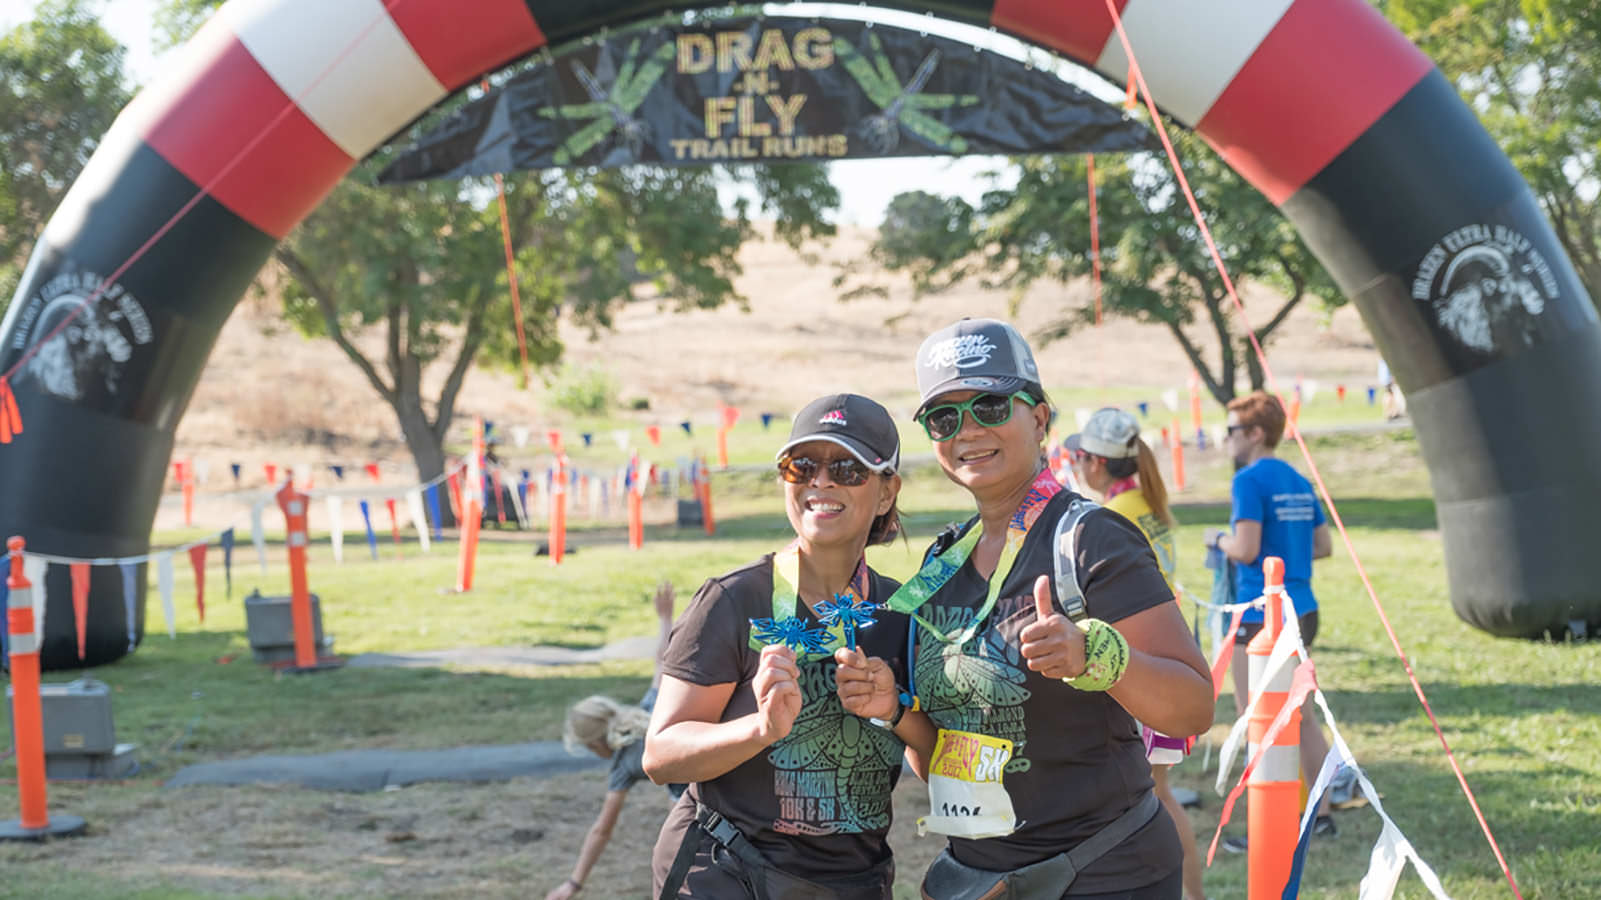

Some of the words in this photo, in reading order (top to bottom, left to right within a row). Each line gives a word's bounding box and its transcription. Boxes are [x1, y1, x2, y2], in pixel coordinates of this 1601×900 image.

[676, 28, 834, 74] DRAG
[704, 93, 807, 138] FLY
[669, 137, 759, 160] TRAIL
[762, 133, 848, 158] RUNS
[976, 745, 1009, 782] 5K
[779, 798, 805, 821] 10K
[818, 798, 835, 821] 5K
